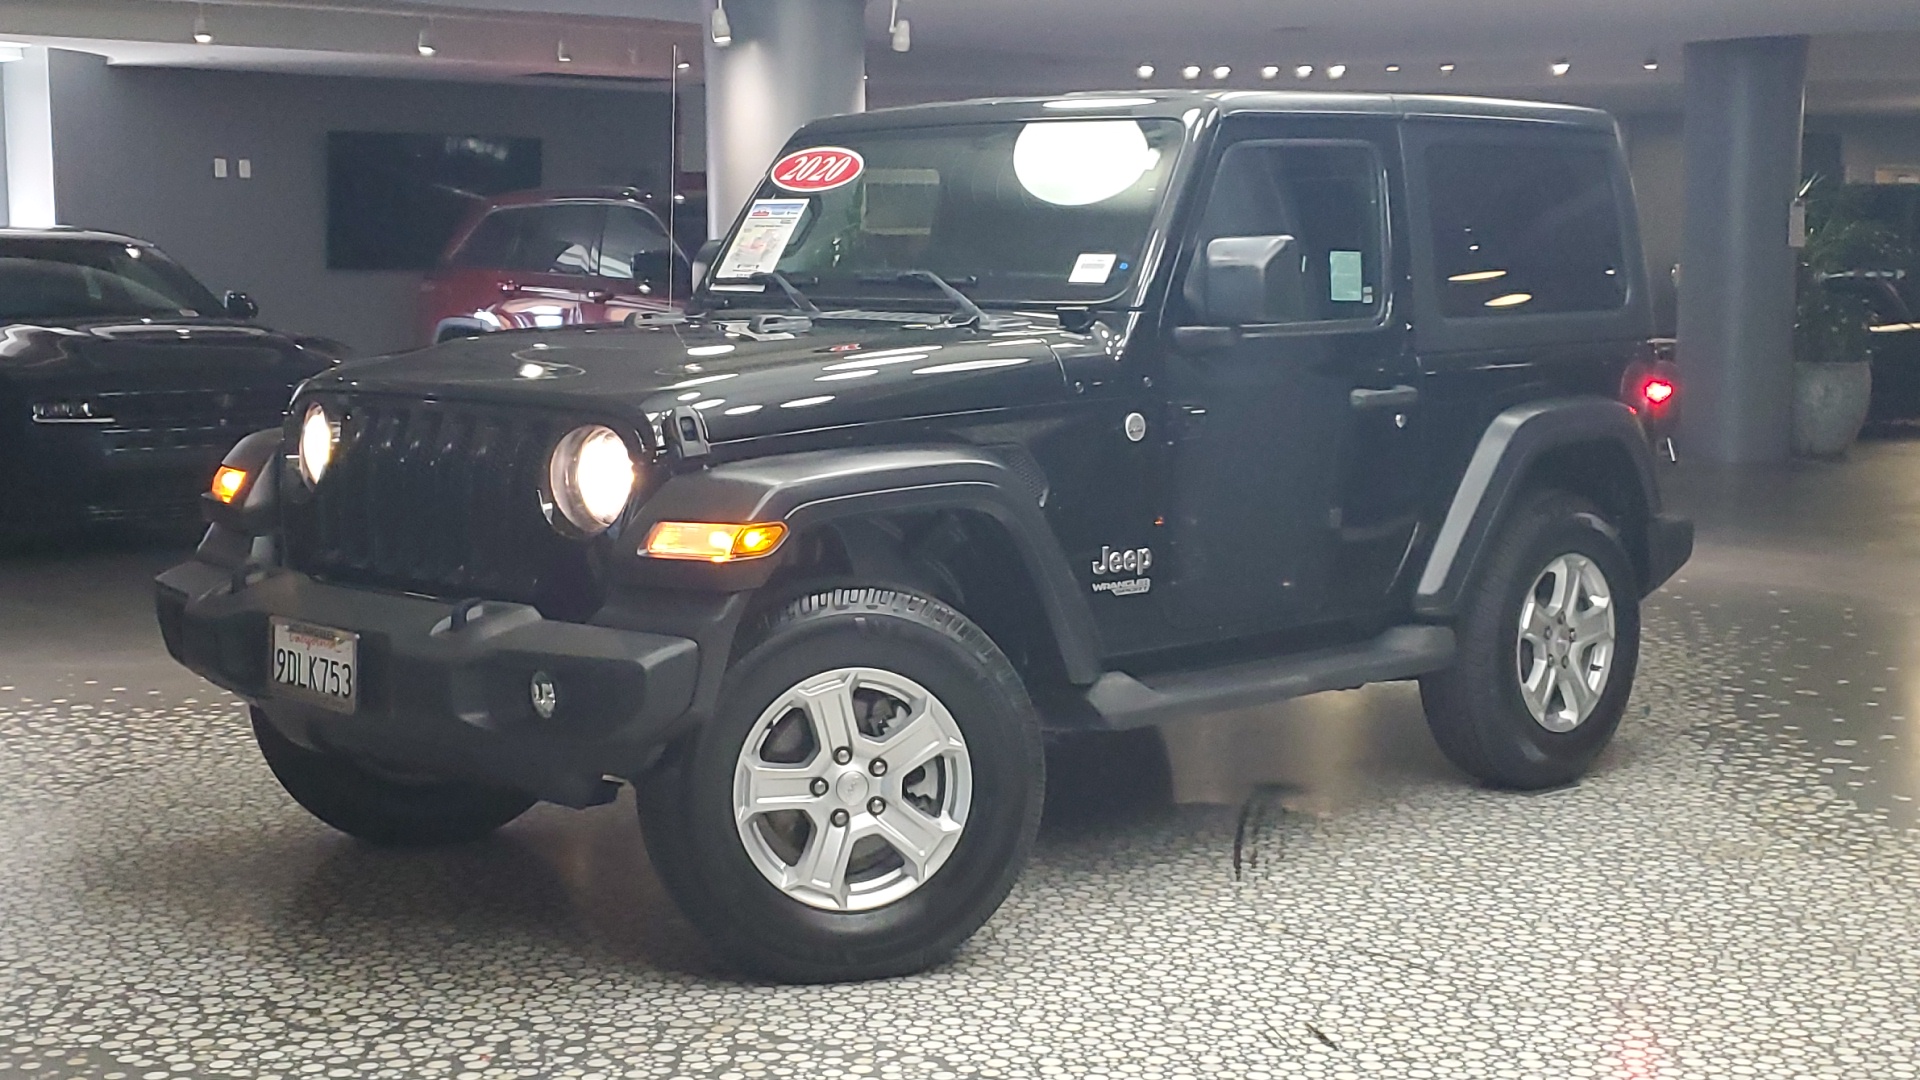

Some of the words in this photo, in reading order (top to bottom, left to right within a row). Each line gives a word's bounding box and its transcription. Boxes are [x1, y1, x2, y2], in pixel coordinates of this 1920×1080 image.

[779, 155, 852, 182] 2020
[1092, 546, 1152, 576] Jeep
[276, 648, 352, 698] 9DLK753
